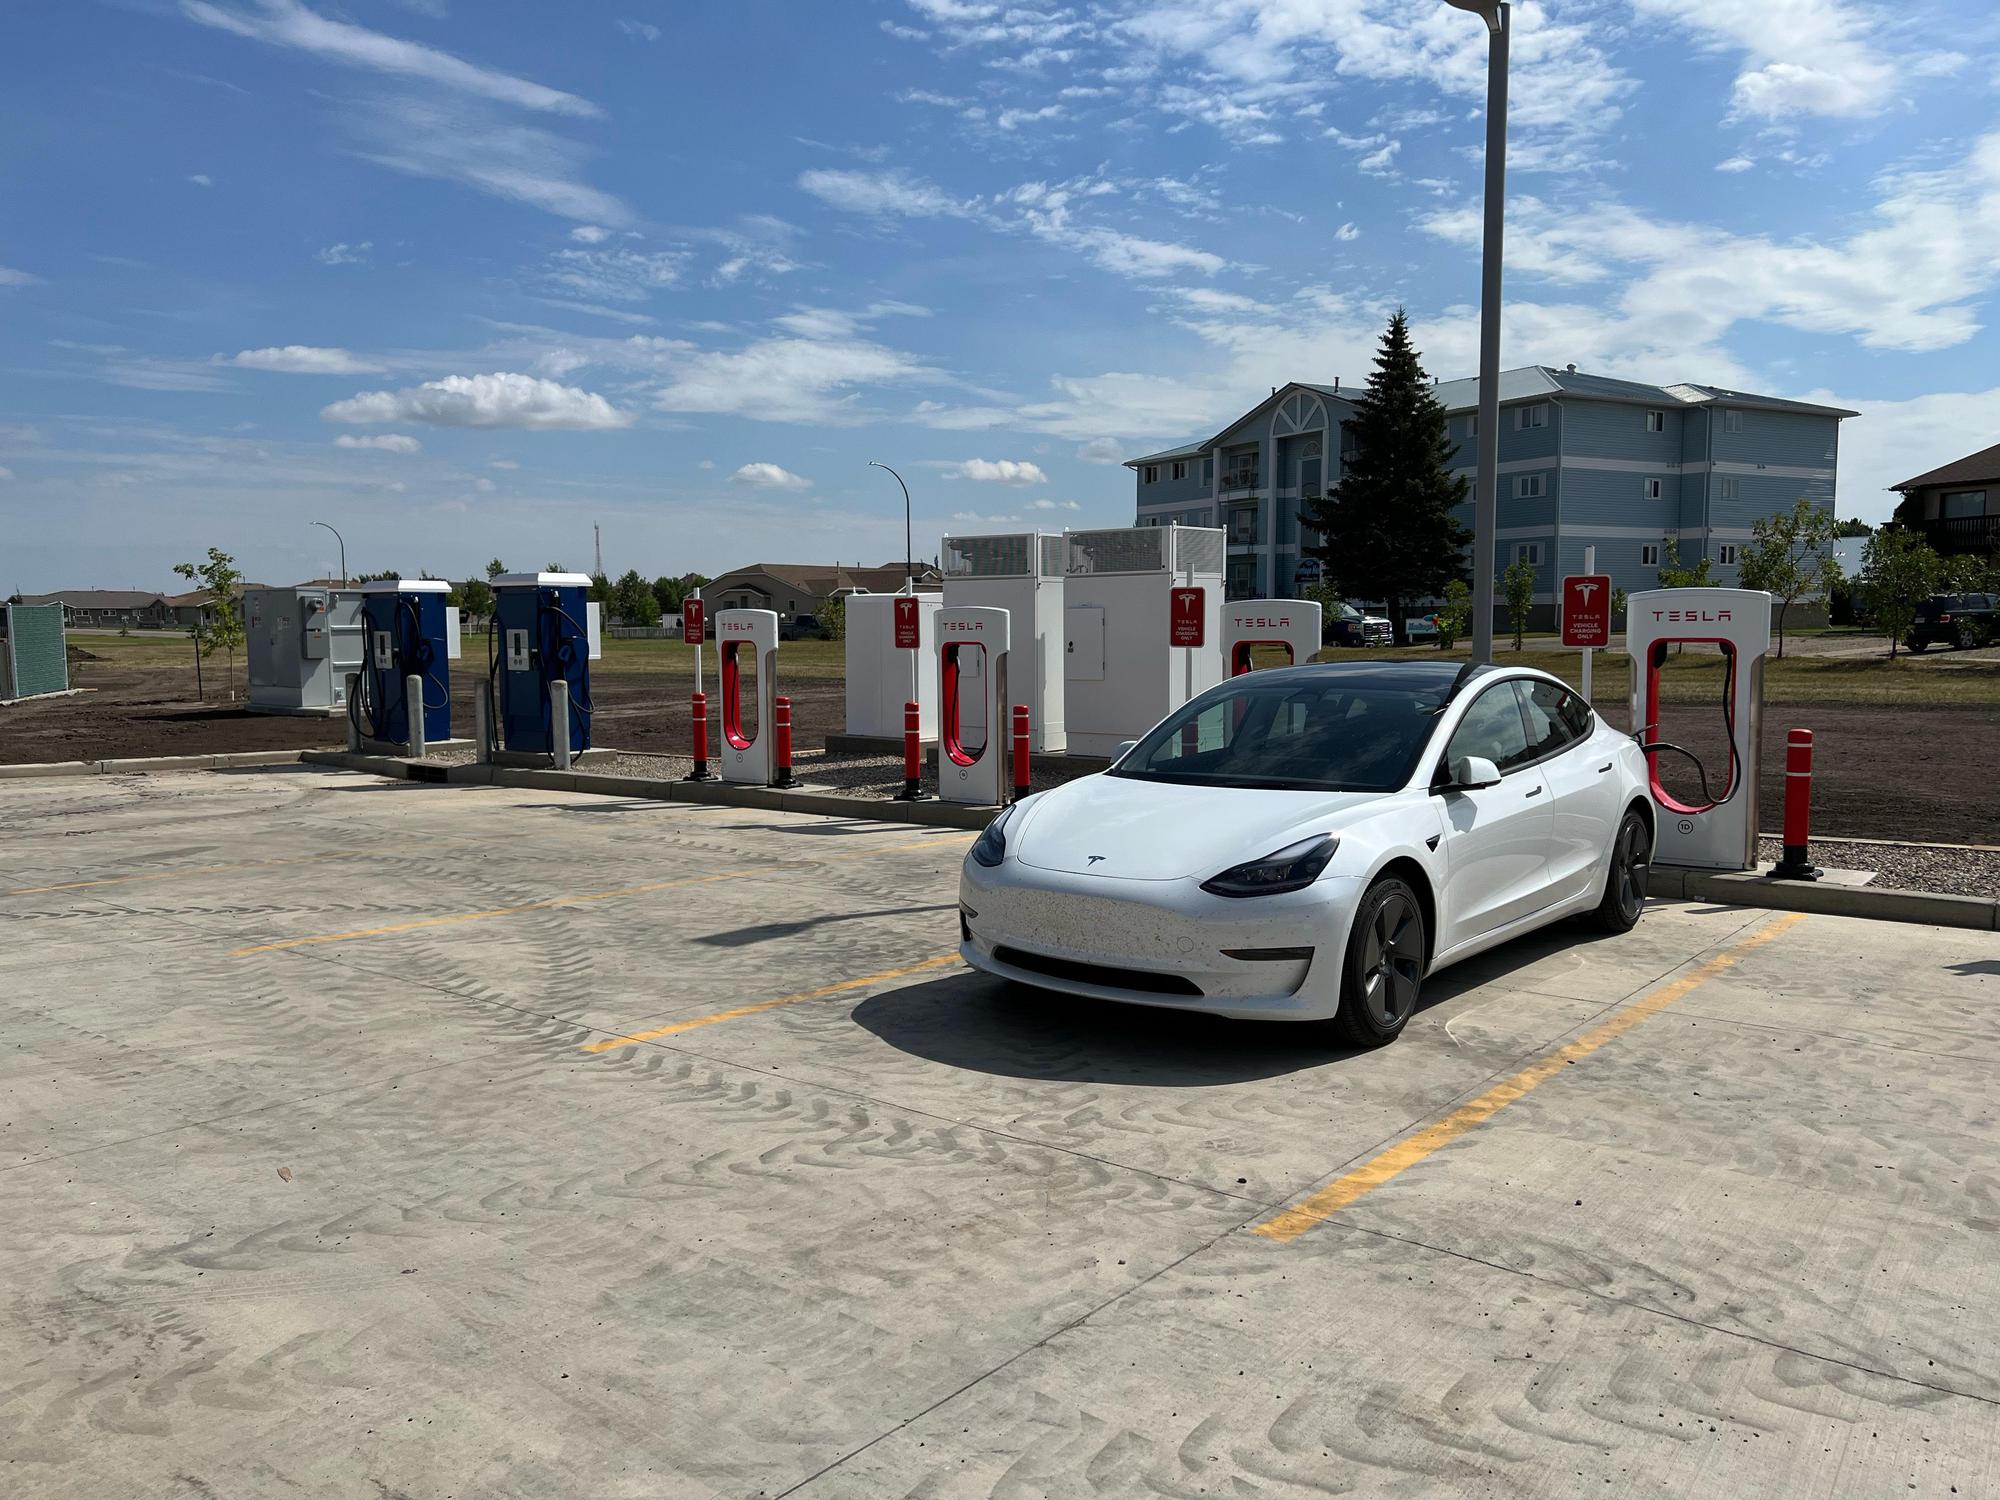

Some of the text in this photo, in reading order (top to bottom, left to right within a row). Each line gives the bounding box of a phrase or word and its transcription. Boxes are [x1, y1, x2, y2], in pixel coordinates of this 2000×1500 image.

[1652, 610, 1731, 622] TESLA
[721, 623, 754, 631] TESLA
[943, 622, 983, 631] TESLA
[1234, 617, 1290, 628] TESLA
